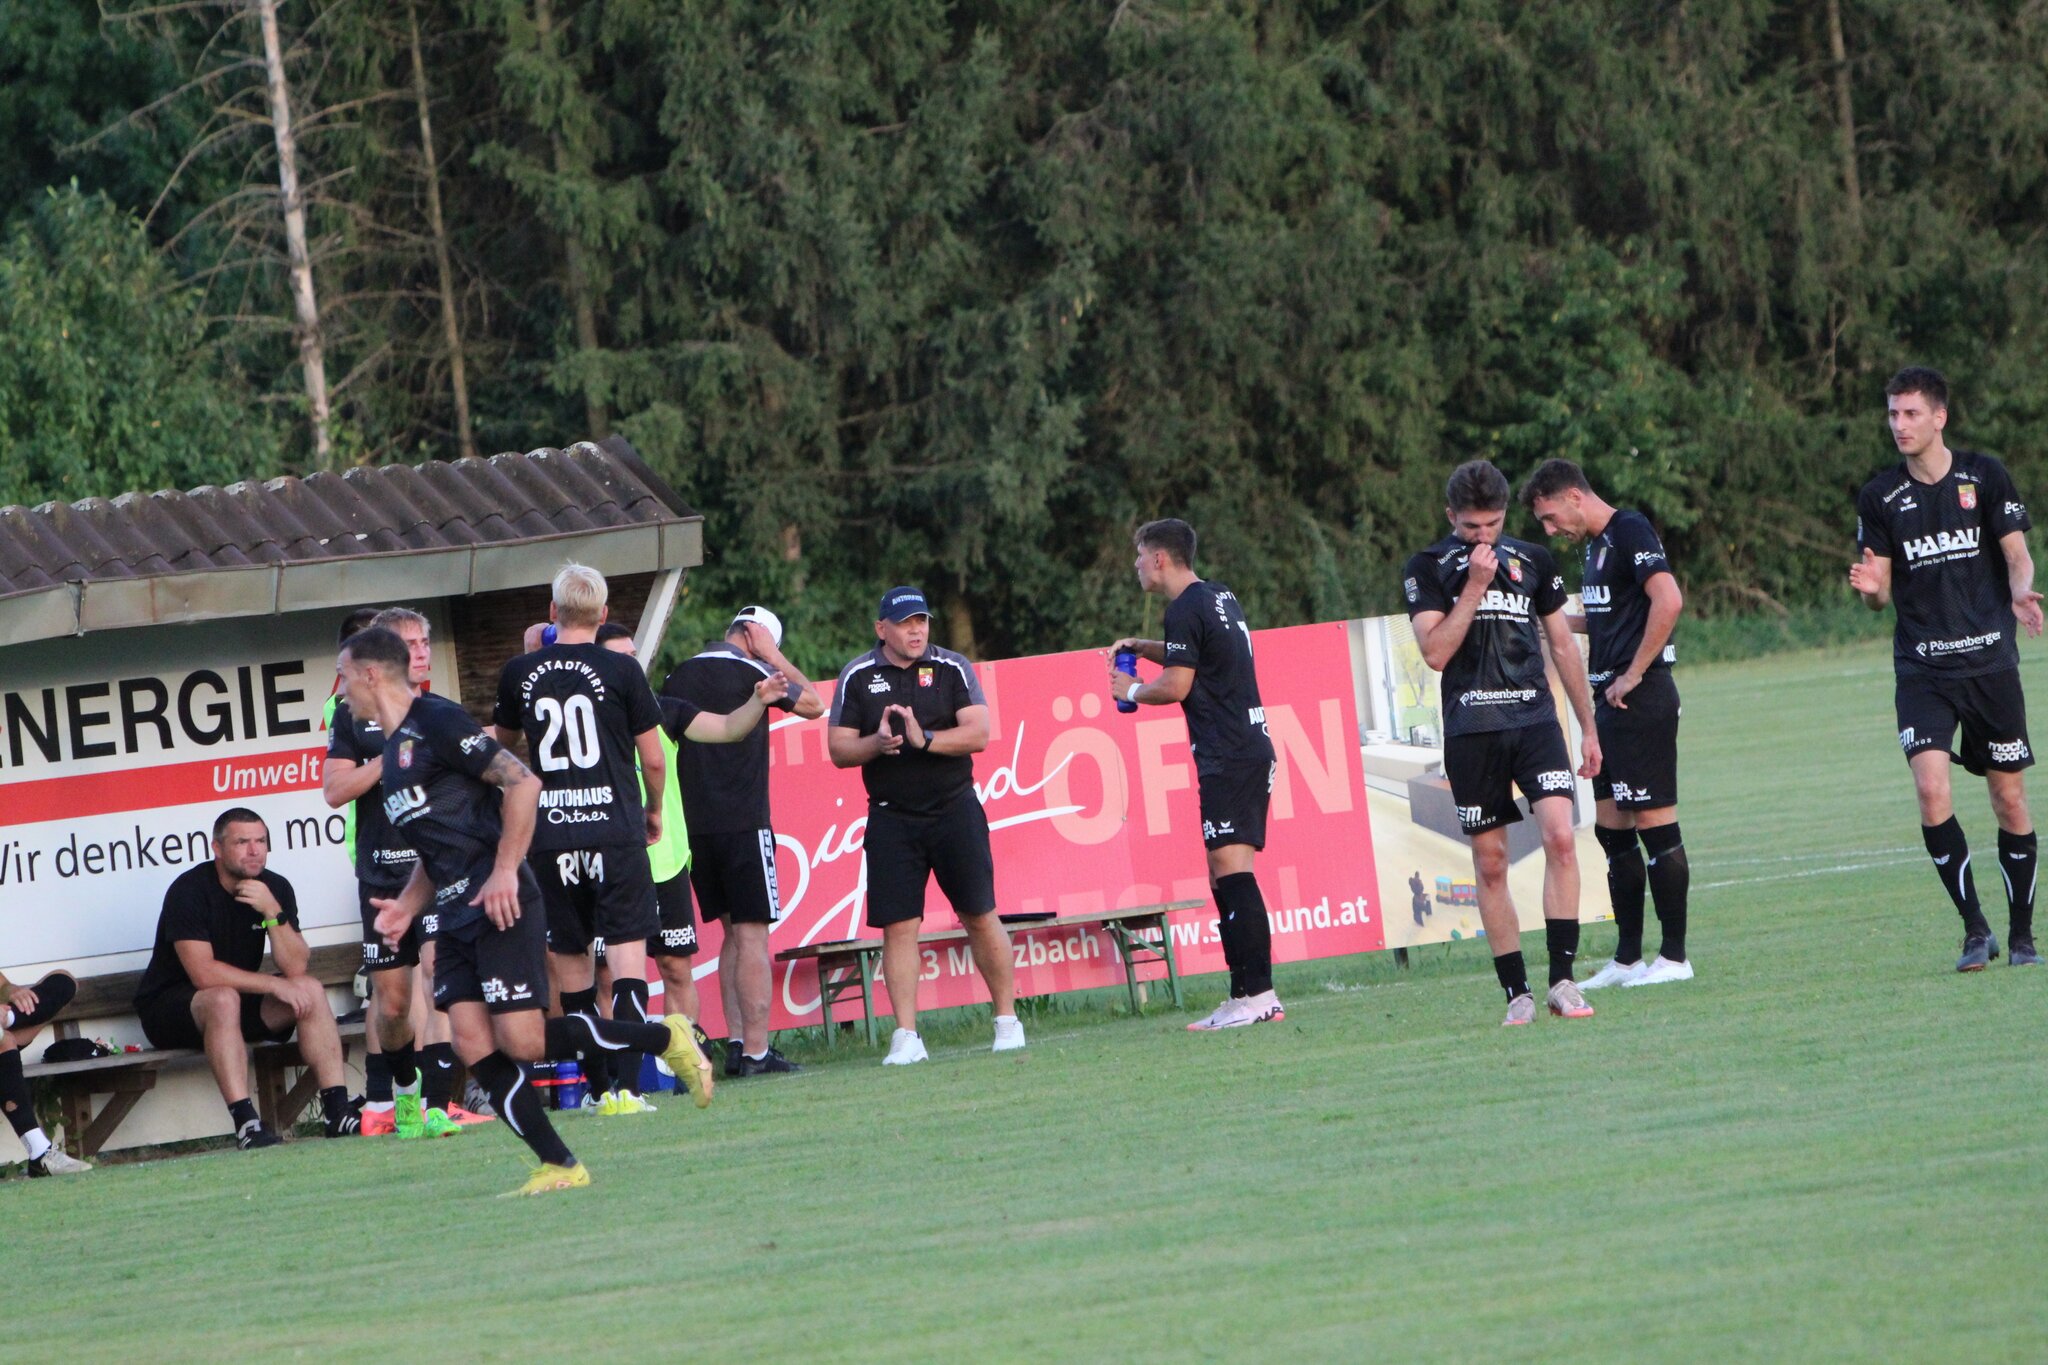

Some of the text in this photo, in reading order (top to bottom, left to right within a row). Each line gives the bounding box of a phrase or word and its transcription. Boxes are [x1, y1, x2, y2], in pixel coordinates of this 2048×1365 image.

[1903, 526, 1981, 561] HABAU
[1930, 631, 2001, 652] Pössenberger
[522, 660, 605, 700] SÜDSTADTWIRT
[1470, 689, 1537, 701] Pössenberger
[0, 660, 311, 768] NERGIE
[535, 694, 600, 772] 20
[1988, 739, 2024, 753] mach
[212, 754, 320, 793] Umwelt
[1042, 691, 1354, 846] ÖFN
[1538, 770, 1572, 783] mach
[538, 786, 613, 808] AUTOHAUS
[548, 808, 609, 824] Ortner
[55, 825, 210, 878] denken
[557, 850, 604, 886] RIVA
[660, 925, 694, 938] mach
[947, 927, 1100, 978] Mzbach
[1130, 895, 1371, 952] www.sund.at
